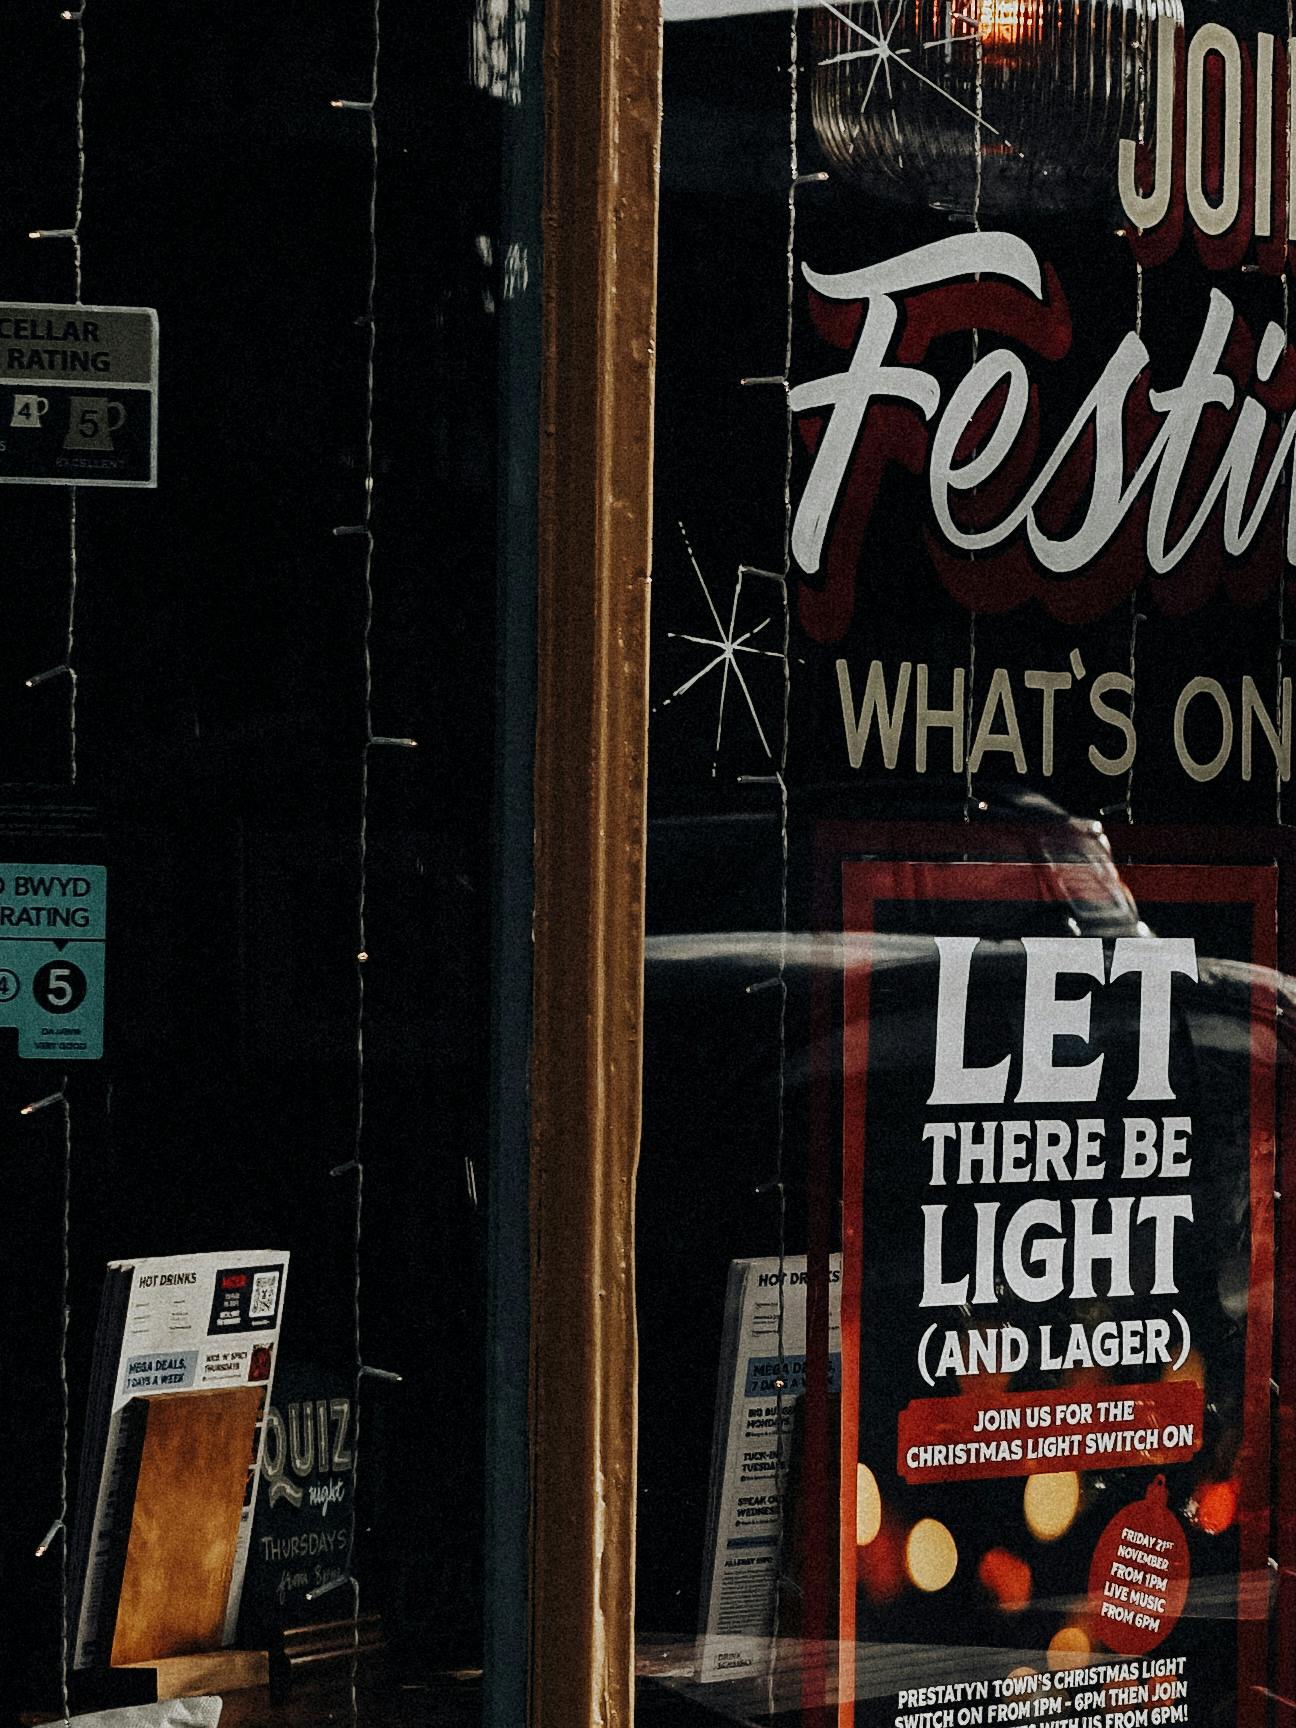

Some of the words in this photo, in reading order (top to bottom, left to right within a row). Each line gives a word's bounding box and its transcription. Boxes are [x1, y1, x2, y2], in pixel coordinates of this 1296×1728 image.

[0, 318, 99, 342] CELLAR
[8, 348, 110, 372] RATING
[18, 403, 32, 420] 4
[80, 410, 99, 438] 5
[836, 650, 1137, 778] WHAT'S
[1173, 677, 1293, 784] ON
[15, 876, 90, 897] BWYD
[0, 906, 90, 928] RATING
[46, 968, 73, 1007] 5
[925, 936, 1198, 1106] LET
[921, 1118, 1107, 1186] THERE
[1120, 1115, 1193, 1180] BE
[918, 1193, 1195, 1308] LIGHT
[139, 1274, 158, 1288] HOT
[160, 1272, 197, 1286] DRINKS
[917, 1320, 1029, 1387] (AND
[1040, 1308, 1192, 1372] LAGER)
[973, 1408, 1021, 1432] JOIN
[1026, 1405, 1052, 1428] US
[1056, 1403, 1093, 1426] FOR
[1097, 1399, 1135, 1423] THE
[261, 1399, 351, 1508] QUIZ
[906, 1441, 1022, 1469] CHRISTMAS
[1027, 1435, 1083, 1460] LIGHT
[1086, 1428, 1160, 1454] SWITCH
[1163, 1424, 1195, 1446] ON
[309, 1478, 346, 1516] night
[261, 1529, 348, 1561] THURSDAYS
[1121, 1527, 1157, 1549] FRIDAY
[1117, 1544, 1169, 1570] NOVEMBER
[1110, 1561, 1144, 1585] FROM
[1145, 1573, 1168, 1592] 1PM
[1103, 1580, 1129, 1602] LIVE
[1129, 1589, 1166, 1614] MUSIC
[1101, 1601, 1135, 1625] FROM
[1135, 1613, 1161, 1633] 6PM
[898, 1680, 989, 1710] PRESTATYN
[992, 1673, 1051, 1698] TOWN'S
[1054, 1662, 1139, 1688] CHRISTMAS
[1142, 1656, 1187, 1679] LIGHT
[957, 1708, 983, 1727] ON
[988, 1702, 1033, 1725] FROM
[1034, 1696, 1063, 1718] 1PM
[1074, 1691, 1107, 1711] 6PM
[1109, 1688, 1149, 1708] THEN
[1150, 1681, 1188, 1703] JOIN
[1150, 1703, 1189, 1726] 6PM!
